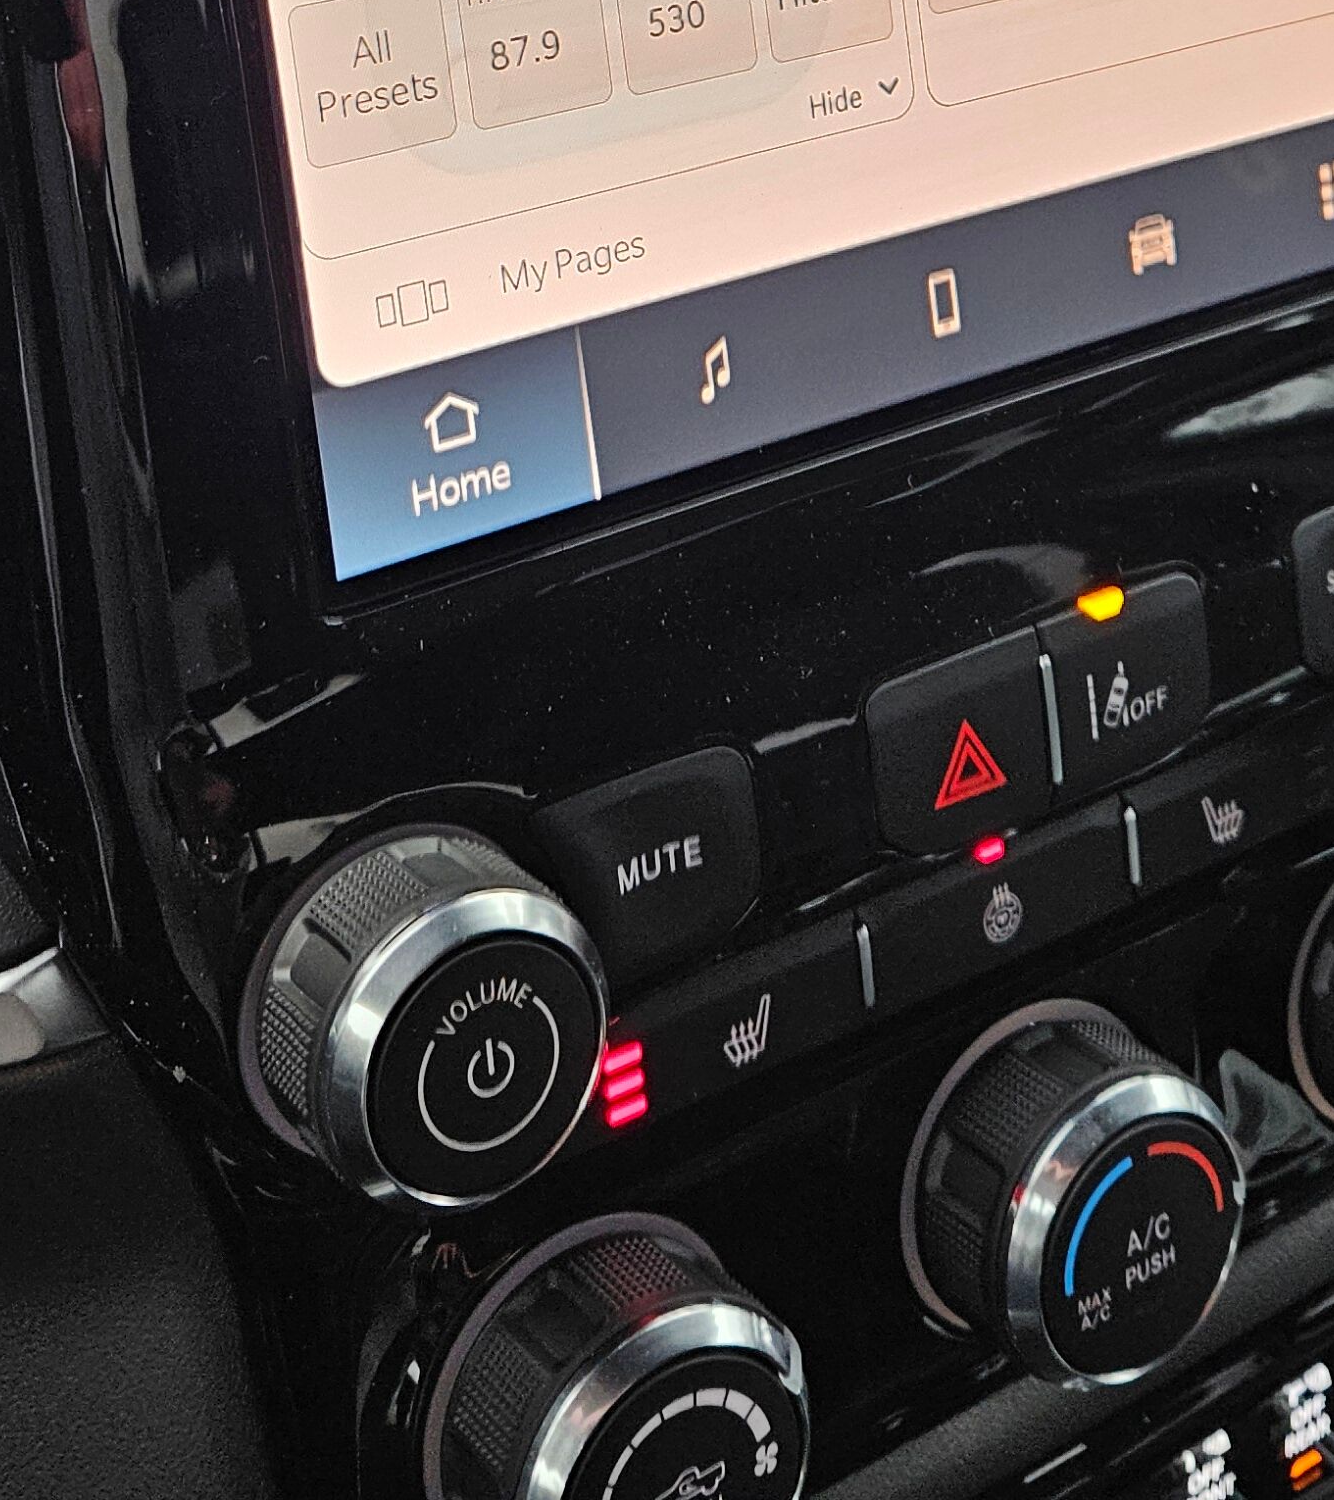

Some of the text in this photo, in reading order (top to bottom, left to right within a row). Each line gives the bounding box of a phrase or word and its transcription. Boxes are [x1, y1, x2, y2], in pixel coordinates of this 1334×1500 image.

[648, 1, 706, 38] 530
[352, 30, 393, 69] All
[490, 30, 561, 71] 87.9
[317, 73, 439, 123] Presets
[809, 87, 863, 119] Hide
[500, 233, 647, 295] My Pages
[411, 459, 512, 516] Home
[1130, 685, 1168, 721] OFF
[616, 836, 703, 896] MUTE
[435, 977, 532, 1038] VOLUME
[1127, 1211, 1170, 1257] A/C
[1125, 1243, 1176, 1291] PUSH
[1078, 1286, 1112, 1316] MAX
[1081, 1304, 1111, 1332] A/C
